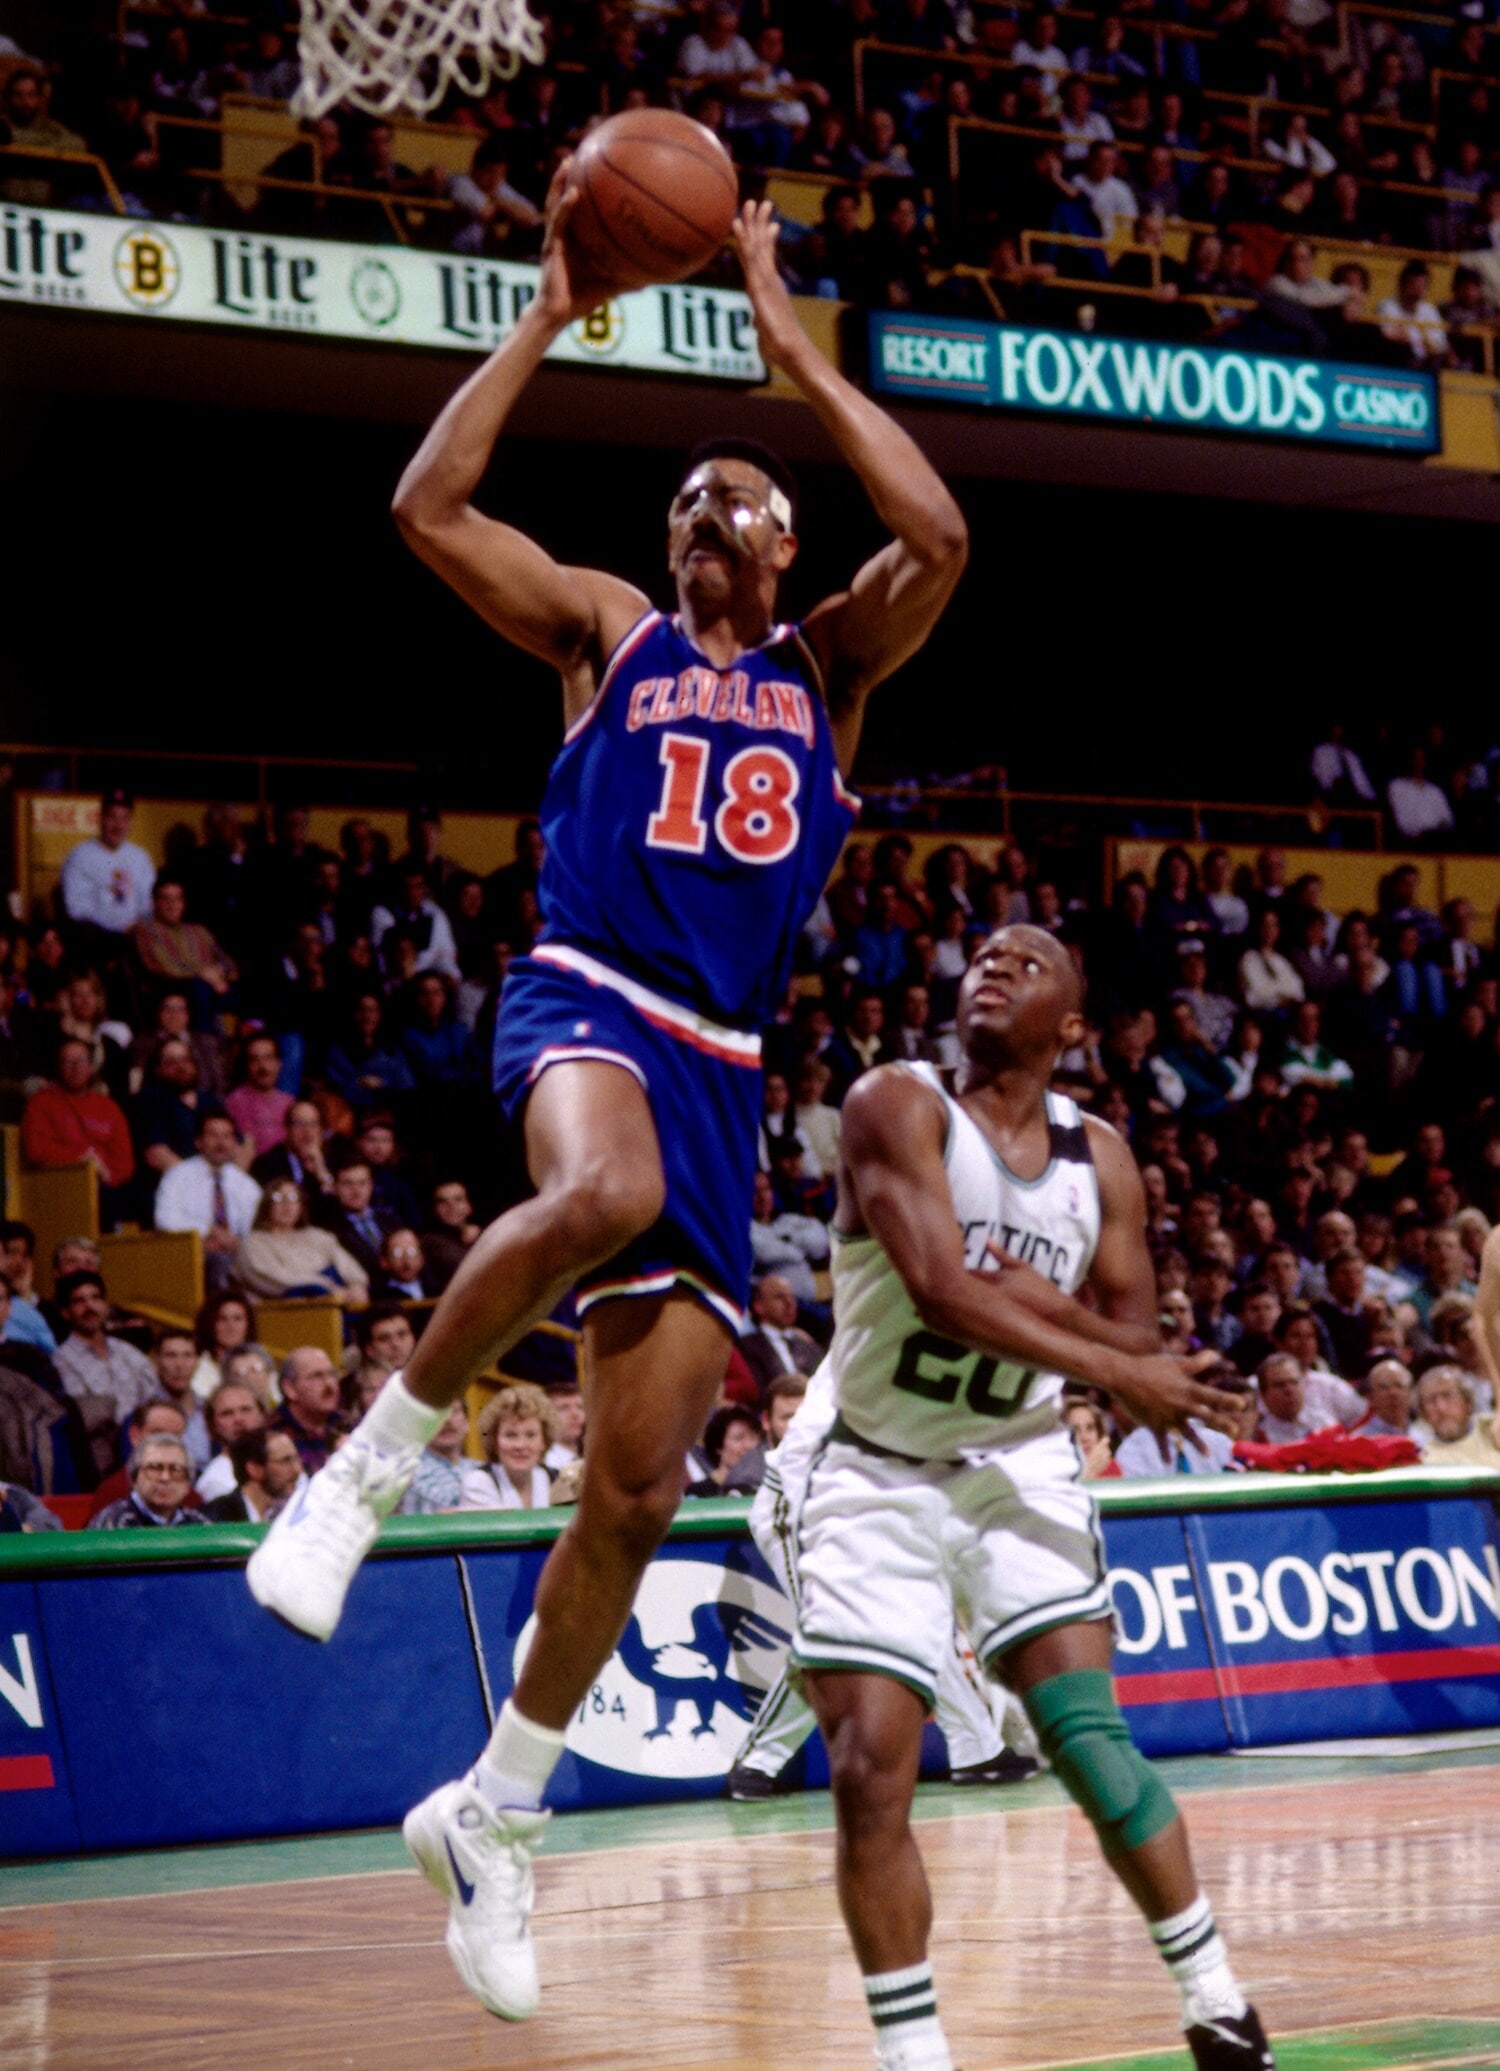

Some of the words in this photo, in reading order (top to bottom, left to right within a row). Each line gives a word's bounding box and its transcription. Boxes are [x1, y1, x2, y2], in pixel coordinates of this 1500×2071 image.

[0, 211, 84, 289] ite
[133, 241, 163, 293] B
[213, 238, 316, 315] Lite
[660, 291, 751, 362] Lite
[882, 334, 988, 381] RESORT
[1001, 330, 1327, 433] FOXWOODS
[1333, 382, 1428, 430] CASINO
[626, 665, 815, 750] CLEVELAND
[645, 731, 800, 864] 18
[957, 1220, 1069, 1286] ELTICS
[1105, 1566, 1198, 1654] OF
[1208, 1546, 1500, 1644] BOSTON
